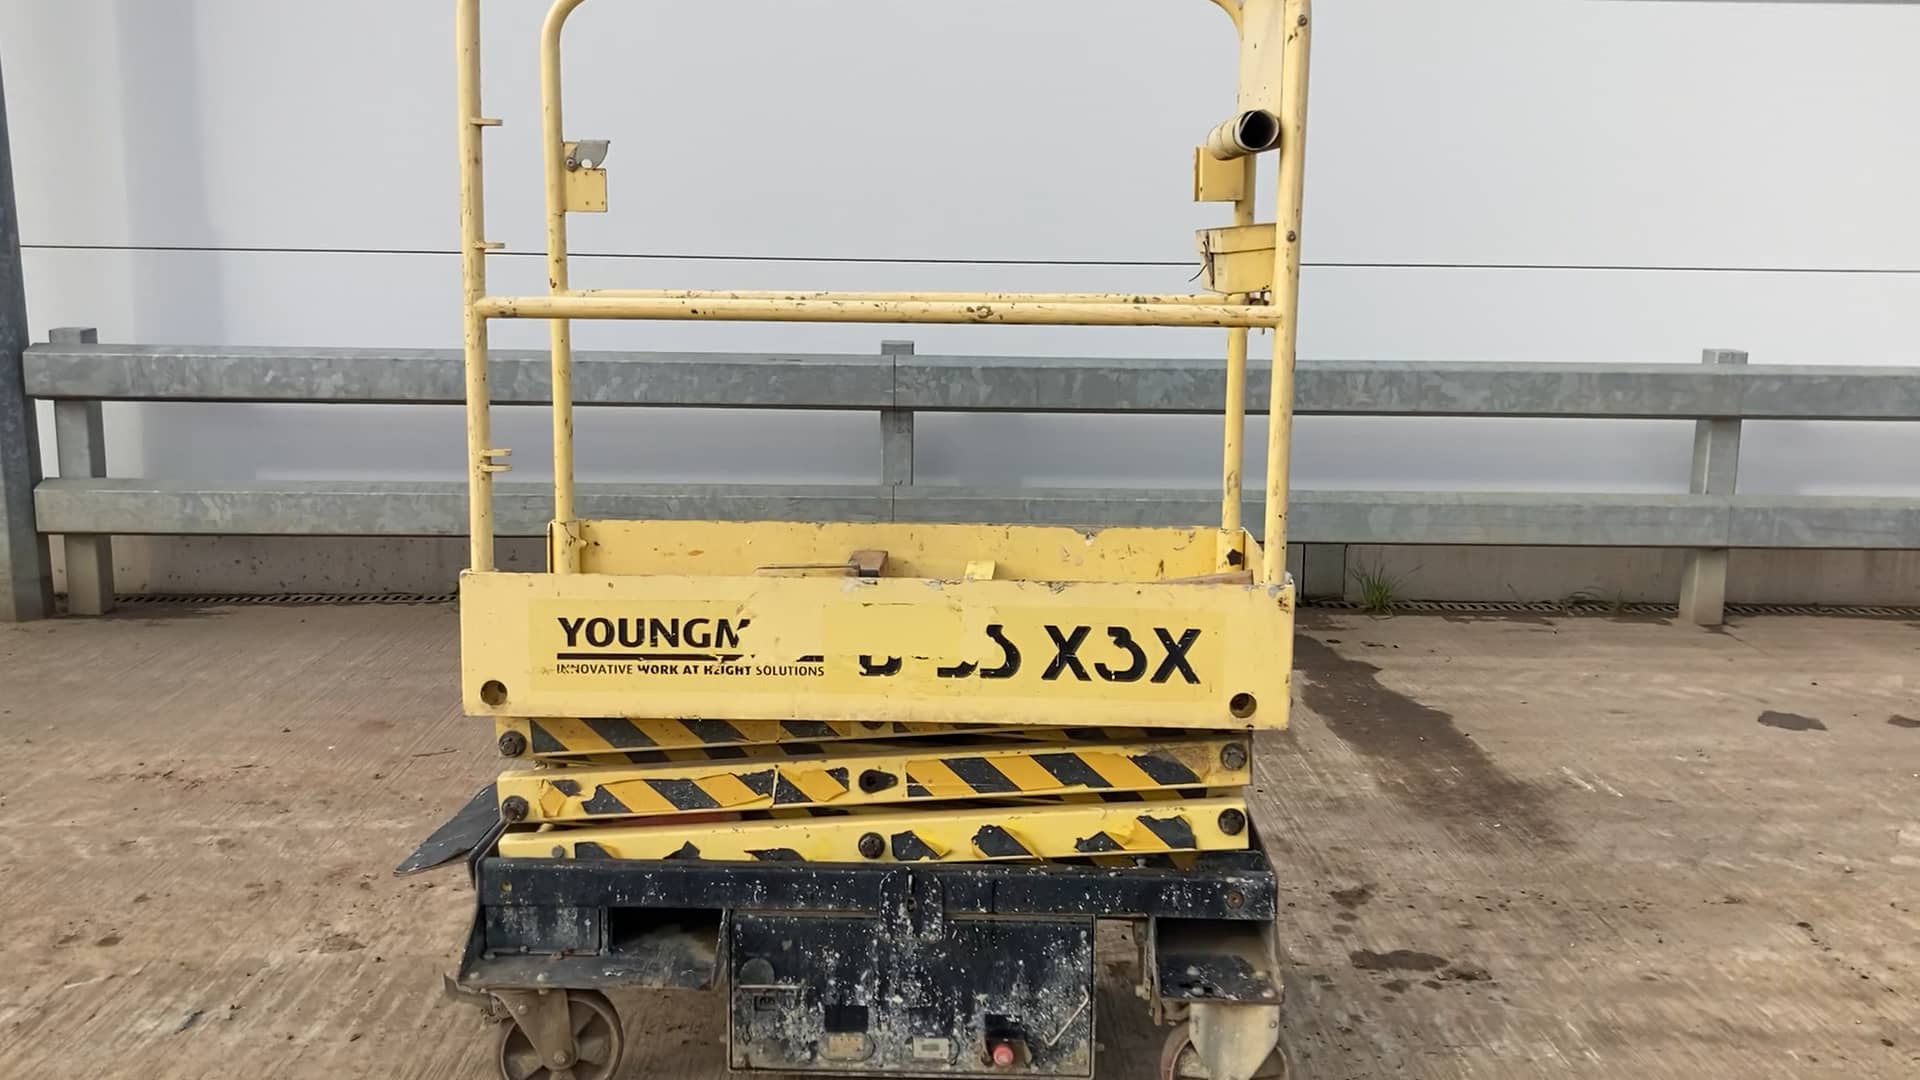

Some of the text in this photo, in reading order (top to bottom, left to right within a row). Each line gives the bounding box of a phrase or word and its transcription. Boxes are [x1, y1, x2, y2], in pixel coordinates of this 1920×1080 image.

[637, 664, 678, 675] WORK
[682, 664, 699, 676] AT
[755, 664, 825, 677] SOLUTIONS
[1041, 624, 1202, 685] X3X
